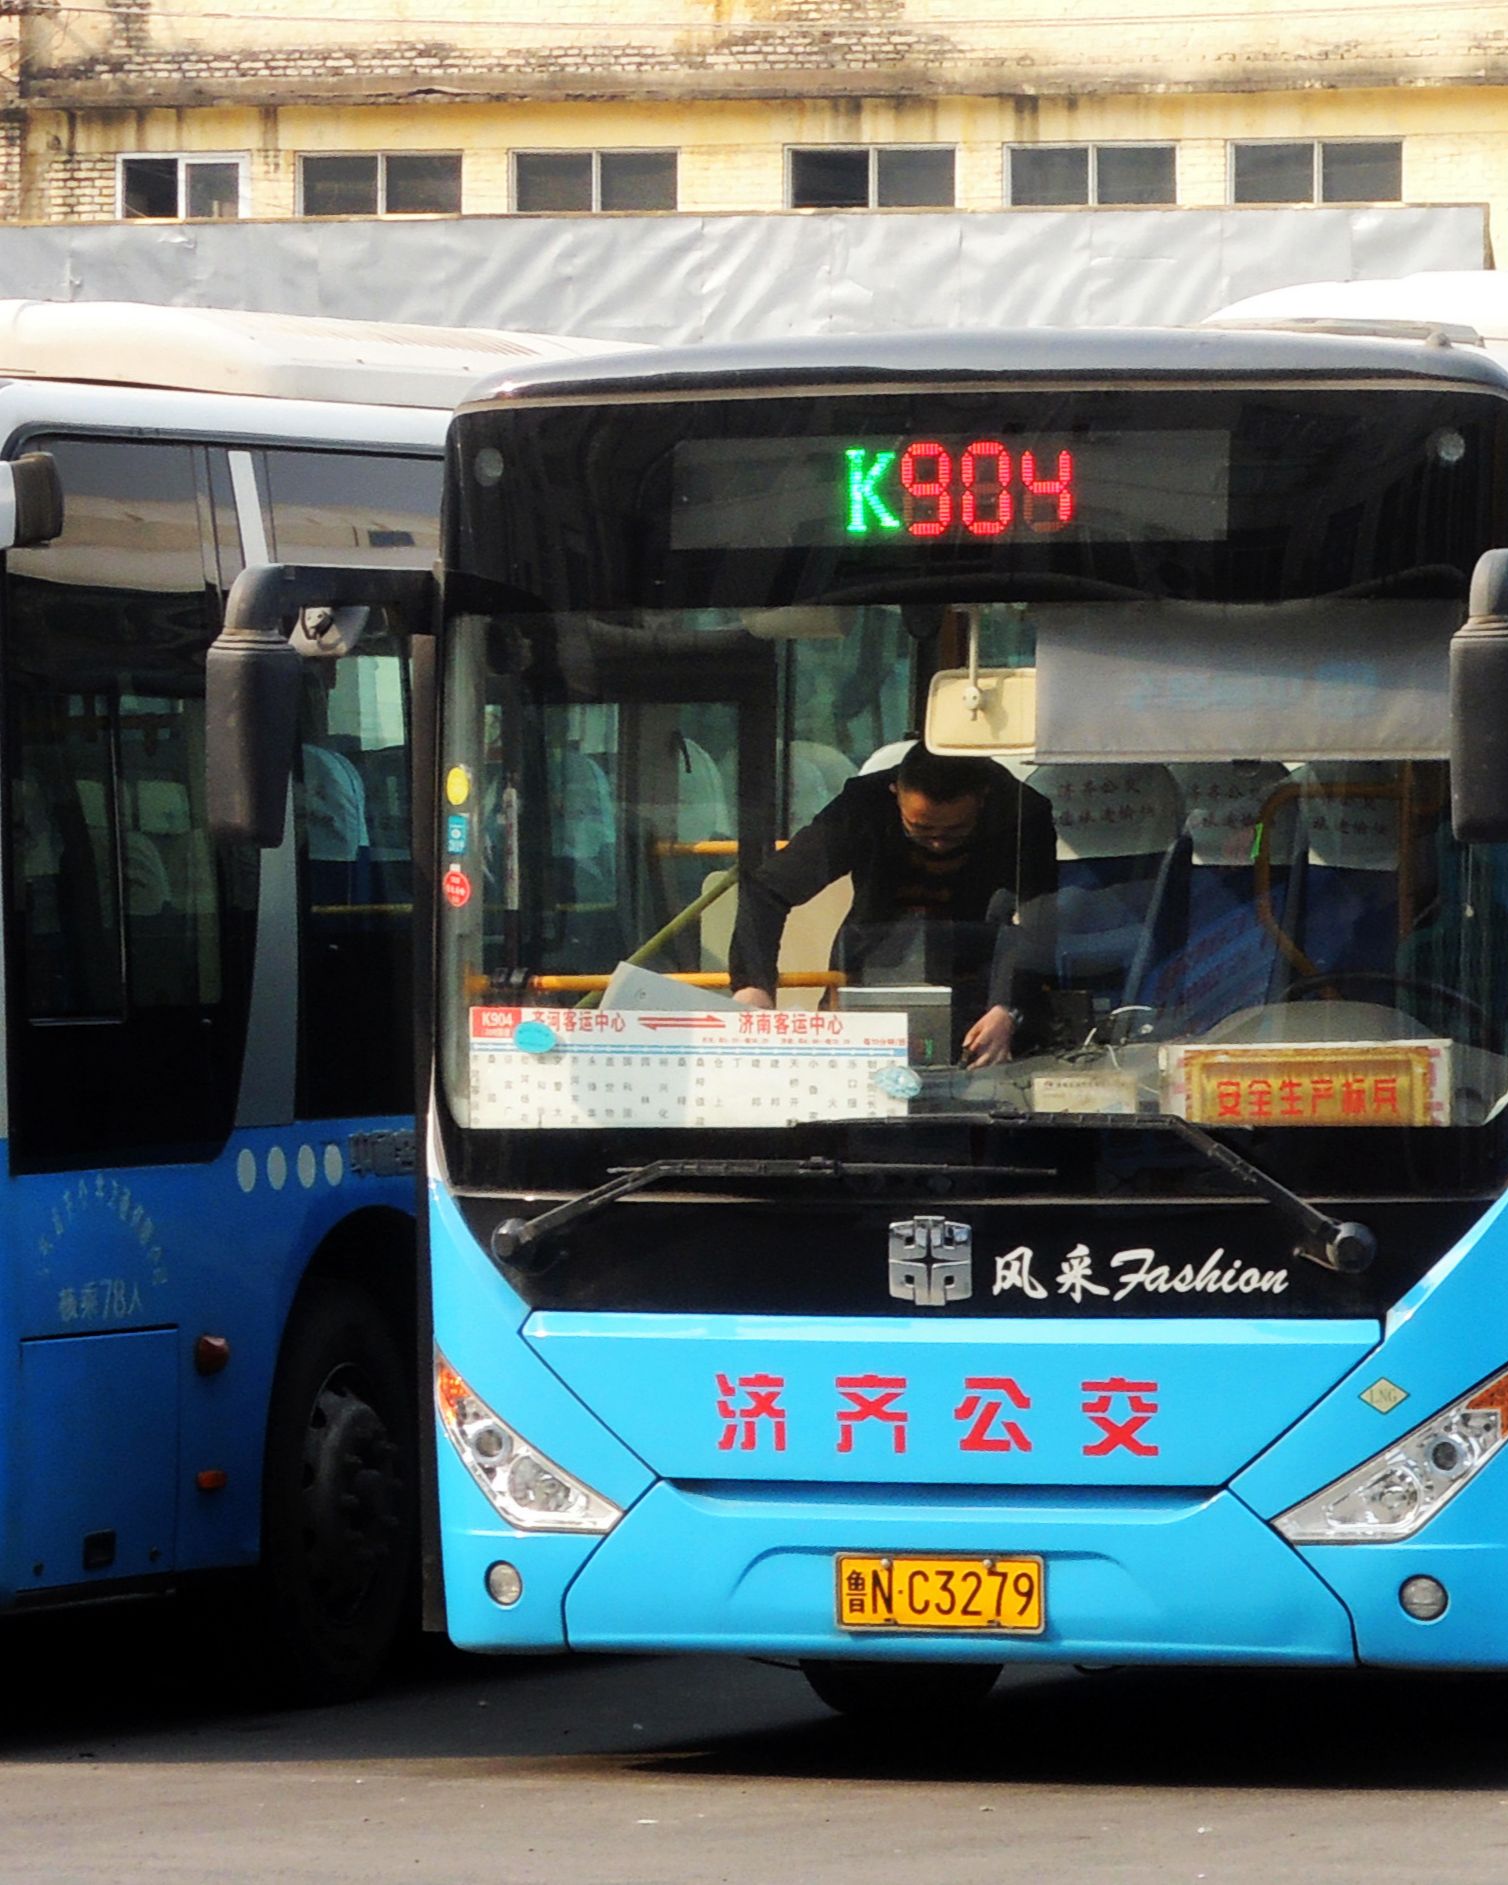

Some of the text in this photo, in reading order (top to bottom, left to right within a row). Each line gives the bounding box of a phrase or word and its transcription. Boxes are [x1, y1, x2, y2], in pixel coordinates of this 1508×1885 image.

[846, 440, 1075, 537] K904
[481, 1011, 513, 1027] K904
[738, 1013, 844, 1035] 济南客运中心
[1216, 1077, 1399, 1119] 安全生产标兵
[991, 1243, 1289, 1302] 风采 Fashion
[714, 1373, 1160, 1457] 济齐公交
